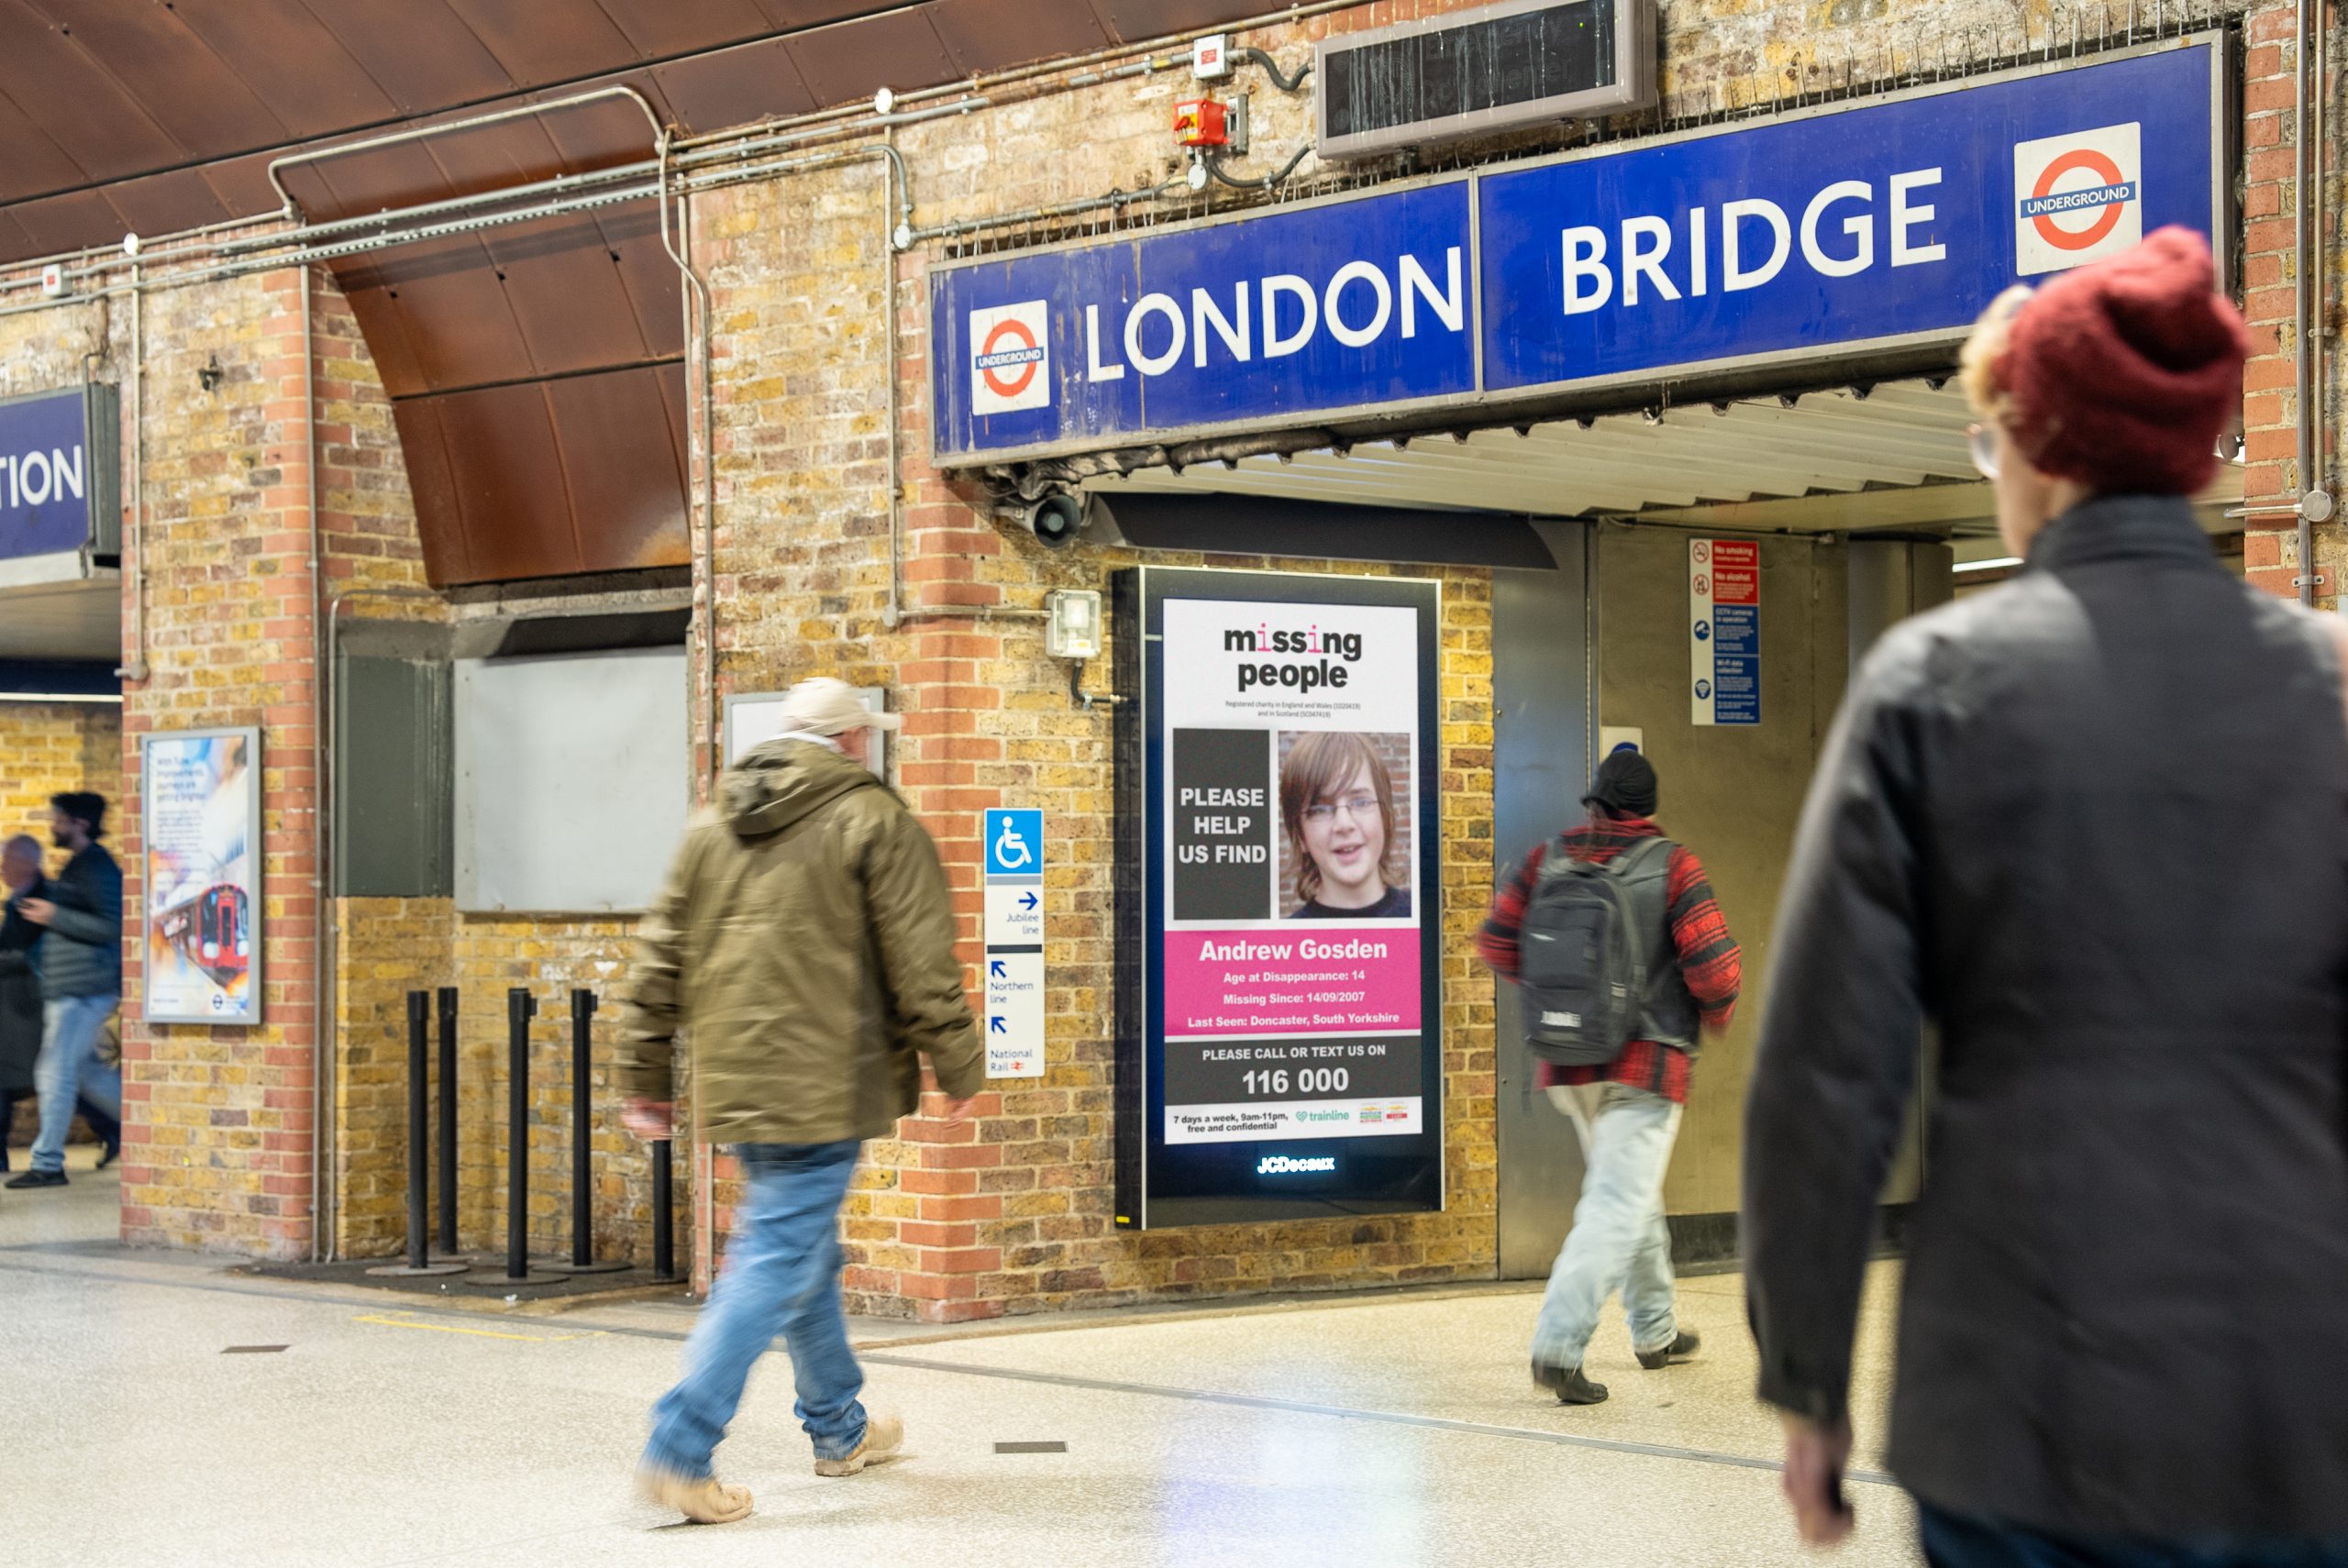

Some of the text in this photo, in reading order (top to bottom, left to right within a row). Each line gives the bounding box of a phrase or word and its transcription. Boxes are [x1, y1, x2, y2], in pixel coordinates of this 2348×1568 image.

[2027, 186, 2129, 214] UNDERGROUND
[1086, 167, 1946, 383] LONDON BRIDGE
[978, 348, 1042, 368] UNDERGROUND
[1224, 623, 1362, 662] missing
[1238, 659, 1348, 693] people
[1225, 701, 1255, 709] Registered
[1256, 701, 1274, 709] charity
[1281, 701, 1303, 710] England
[1180, 788, 1264, 807] PLEASE
[1194, 816, 1251, 834] HELP
[1179, 845, 1267, 864] US FIND
[1006, 913, 1039, 922] Jubilee
[1023, 924, 1039, 934] line
[1199, 939, 1388, 961] Andrew Gosden
[1224, 970, 1365, 984] Age at Disappearance: 14
[991, 982, 1034, 991] Northern
[991, 994, 1007, 1004] line
[1224, 991, 1365, 1006] Missing Since: 14/09/2007
[1188, 1012, 1400, 1028] Last Seen: Doncaster, South Yorkshire
[991, 1048, 1033, 1059] National
[1202, 1044, 1386, 1061] PLEASE CALL OR TEXT US ON
[991, 1062, 1009, 1072] Rail
[1242, 1067, 1349, 1094] 116 000
[1174, 1116, 1180, 1124] 7
[1181, 1114, 1203, 1125] days
[1213, 1113, 1239, 1123] week,
[1241, 1112, 1289, 1122] 9am-11pm,
[1310, 1110, 1349, 1121] trainline
[1188, 1121, 1278, 1133] free and confidential
[1257, 1156, 1335, 1175] JCDecaux
